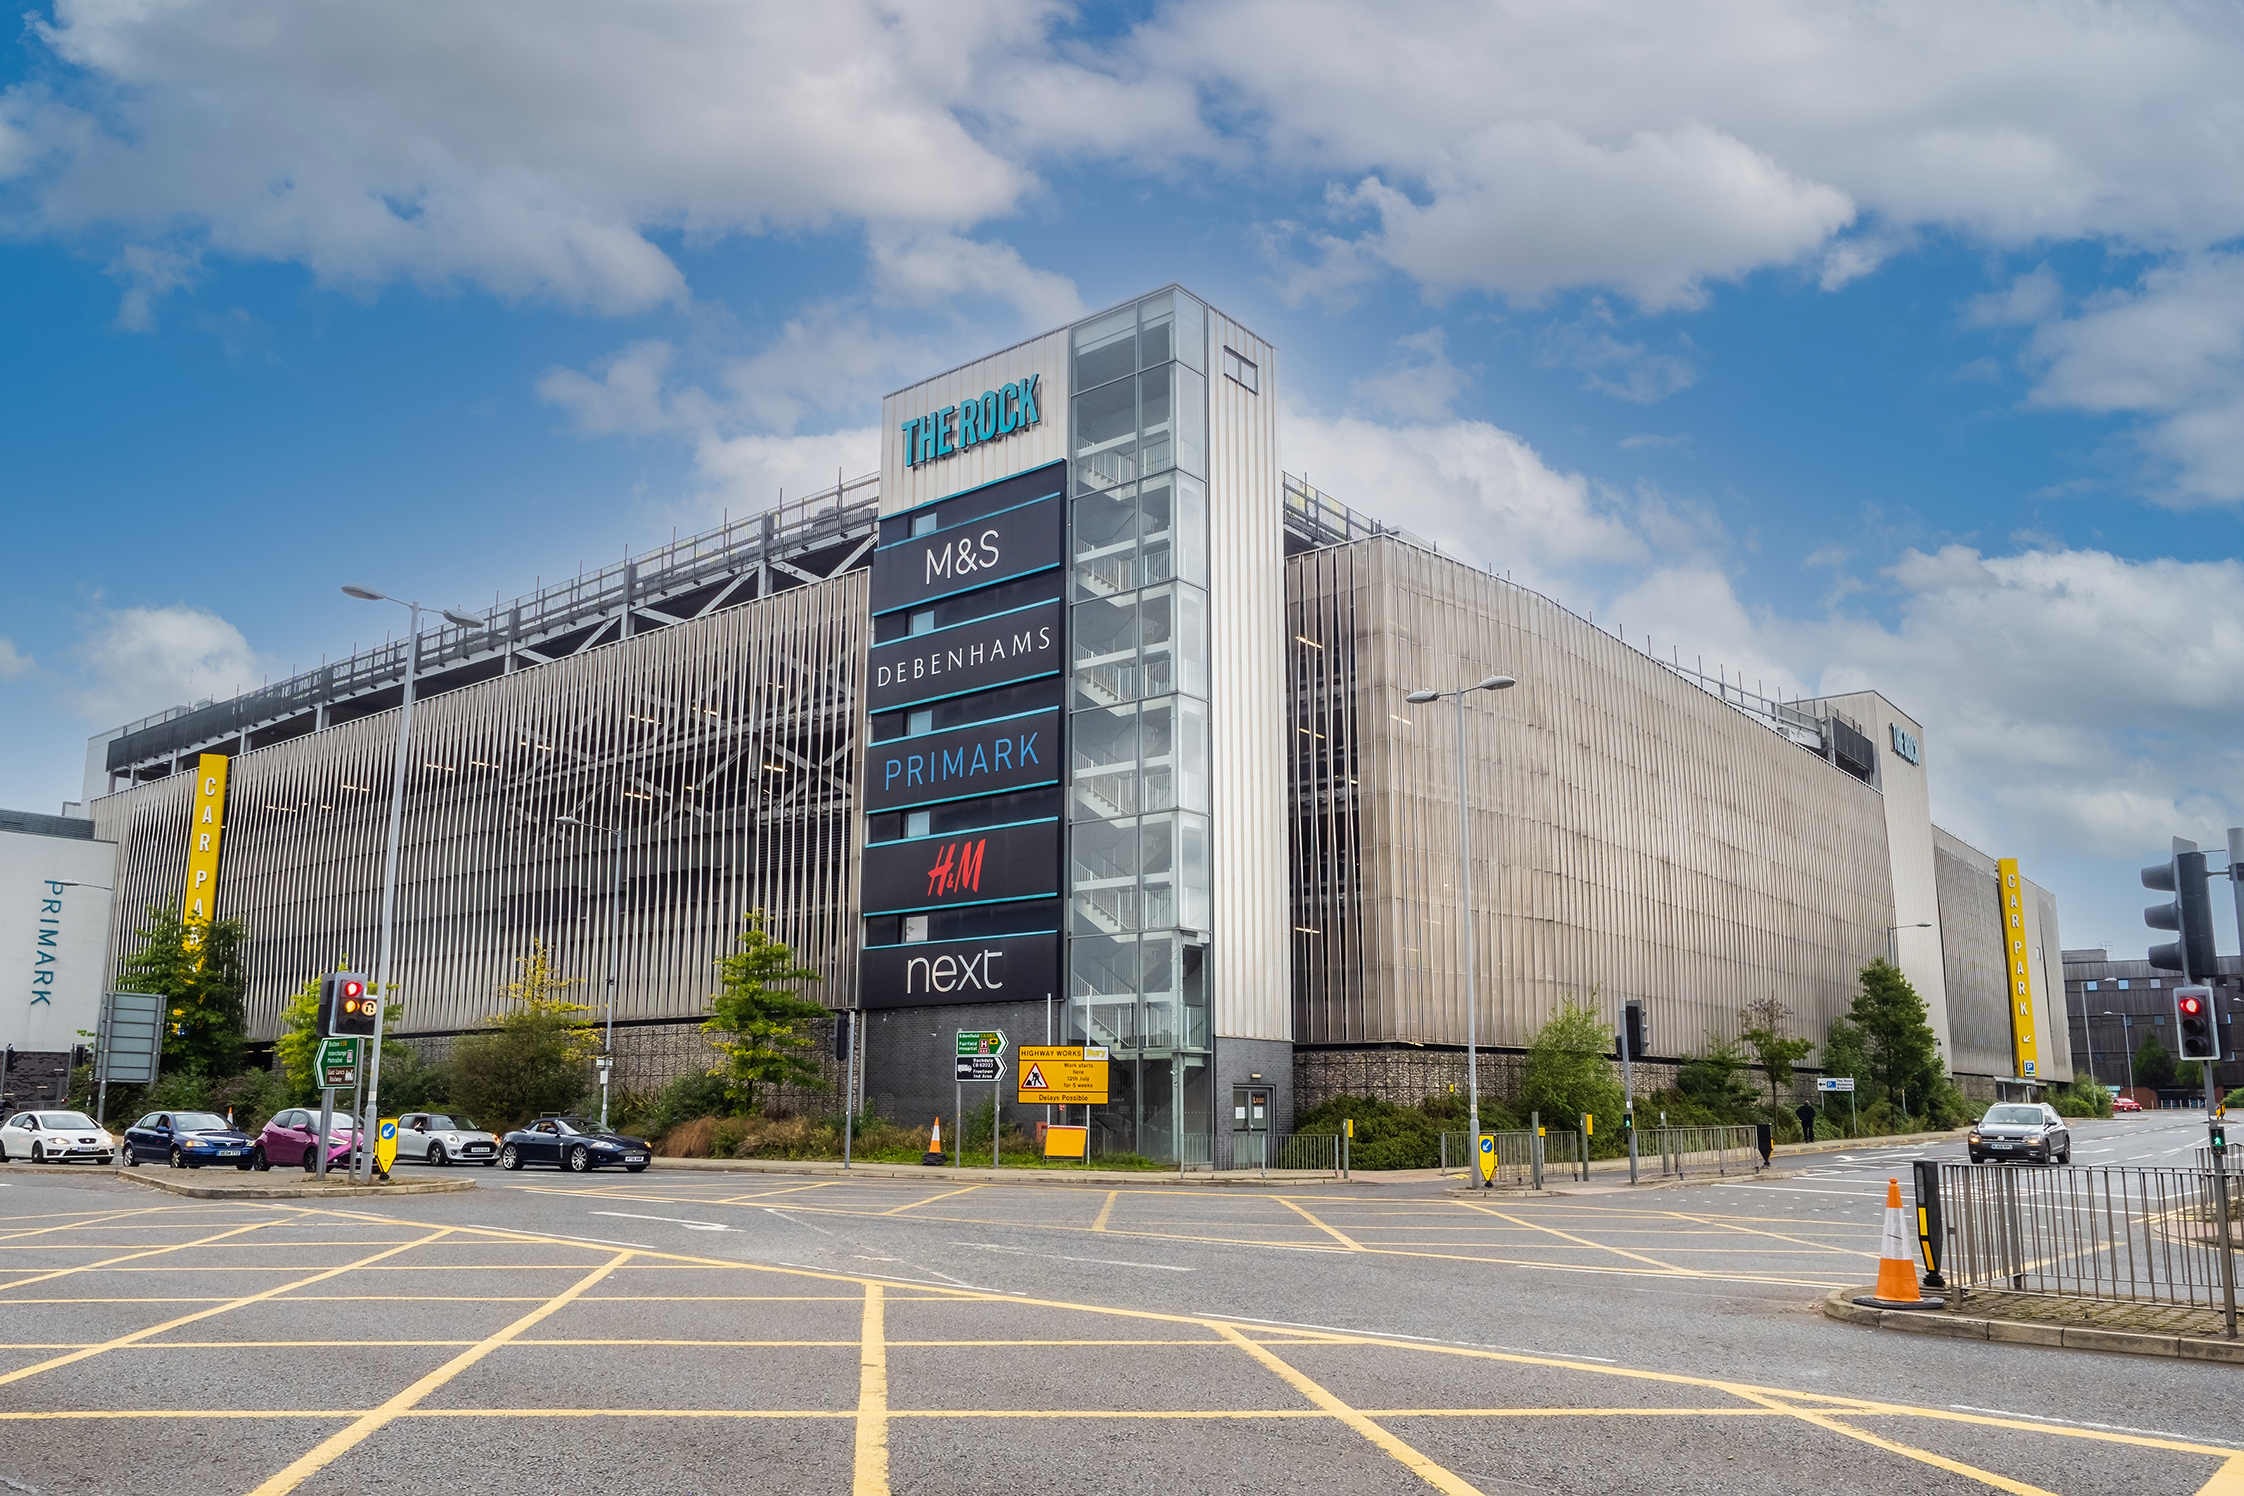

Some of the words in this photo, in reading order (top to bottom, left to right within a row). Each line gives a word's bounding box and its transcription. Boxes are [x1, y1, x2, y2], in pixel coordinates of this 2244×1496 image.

[901, 405, 955, 467] THE
[959, 373, 1040, 448] ROCK
[926, 529, 1000, 585] M&S
[877, 627, 1051, 688] DEBENHAMS
[885, 731, 1040, 791] PRIMARK
[199, 776, 217, 853] CAR
[927, 838, 986, 897] H&M
[30, 879, 64, 1006] PRIMARK
[906, 949, 1004, 994] next
[2007, 873, 2020, 929] CAR
[2014, 940, 2028, 1017] PARK
[981, 1040, 987, 1048] H
[1038, 1094, 1060, 1102] Delays
